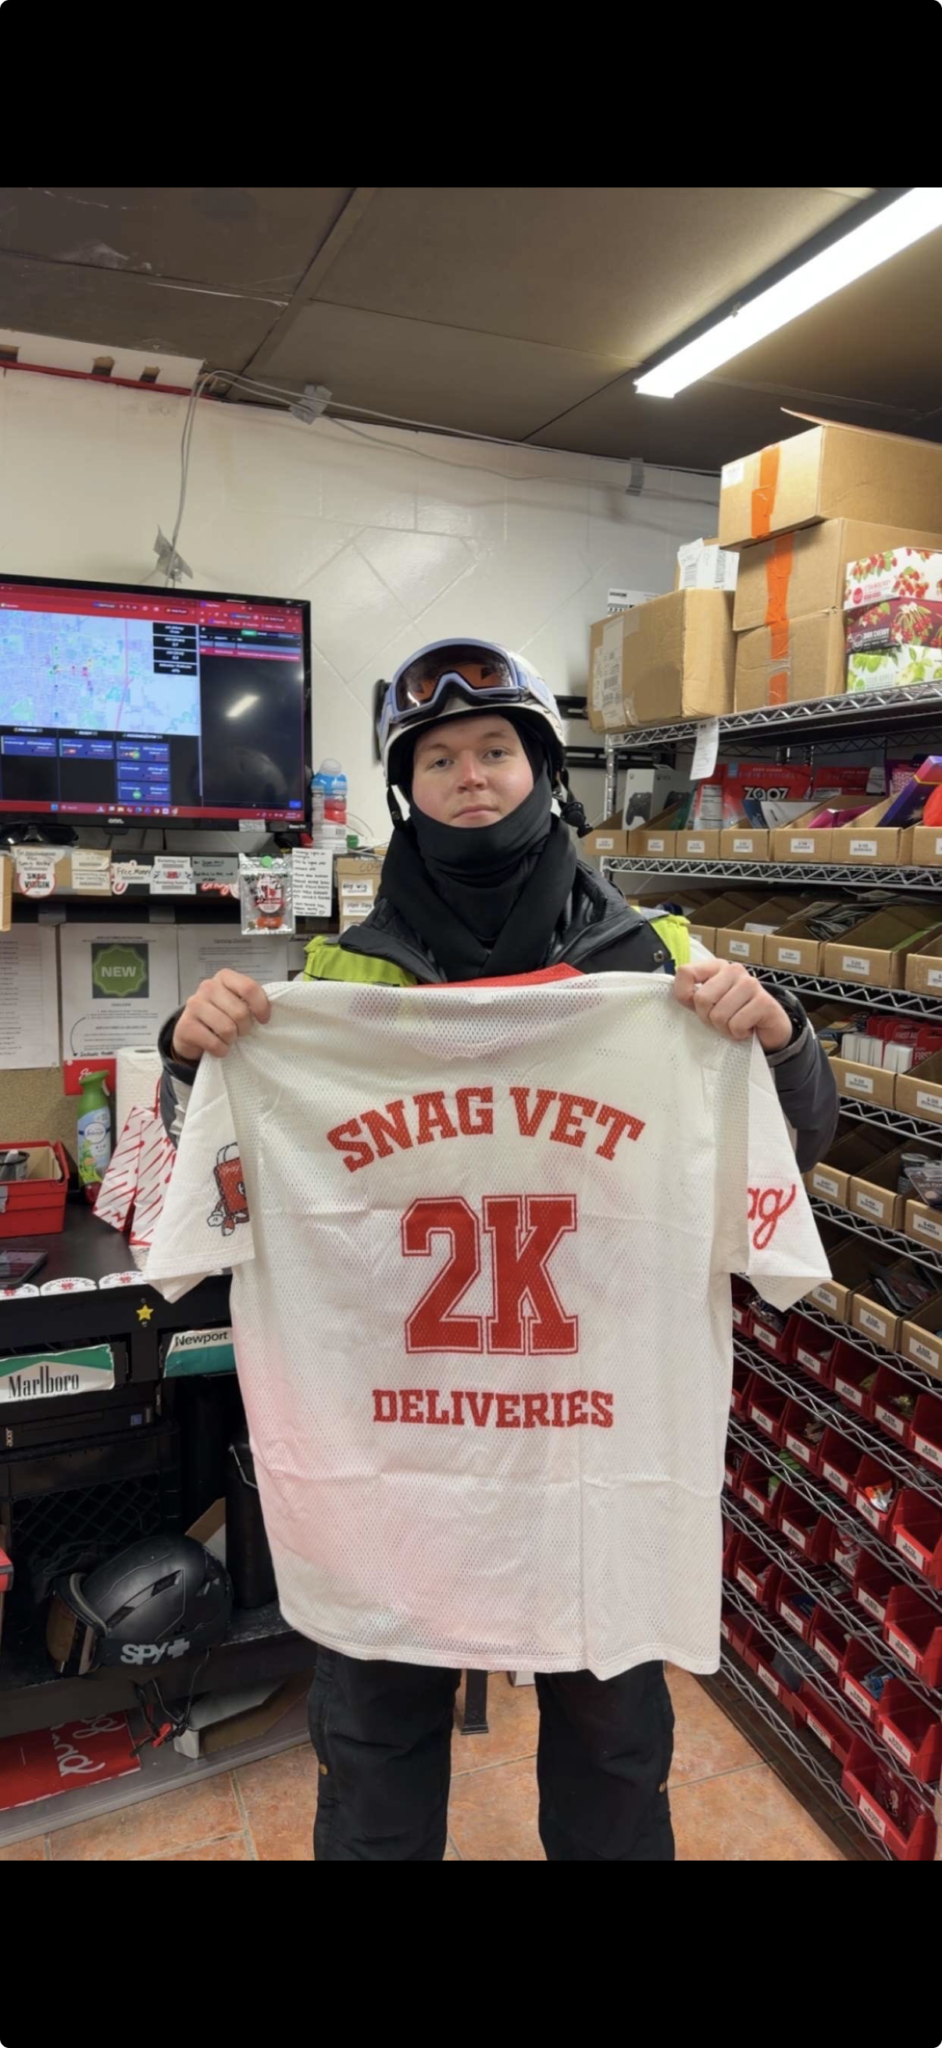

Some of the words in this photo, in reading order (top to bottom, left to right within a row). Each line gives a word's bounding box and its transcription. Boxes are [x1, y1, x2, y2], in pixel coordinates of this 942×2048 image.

[101, 966, 136, 977] NEW
[326, 1086, 494, 1173] SNAG
[509, 1086, 646, 1162] VET
[401, 1194, 579, 1355] 2K
[175, 1331, 228, 1347] Newport
[8, 1366, 79, 1398] Marlboro
[373, 1389, 614, 1428] DELIVERIES
